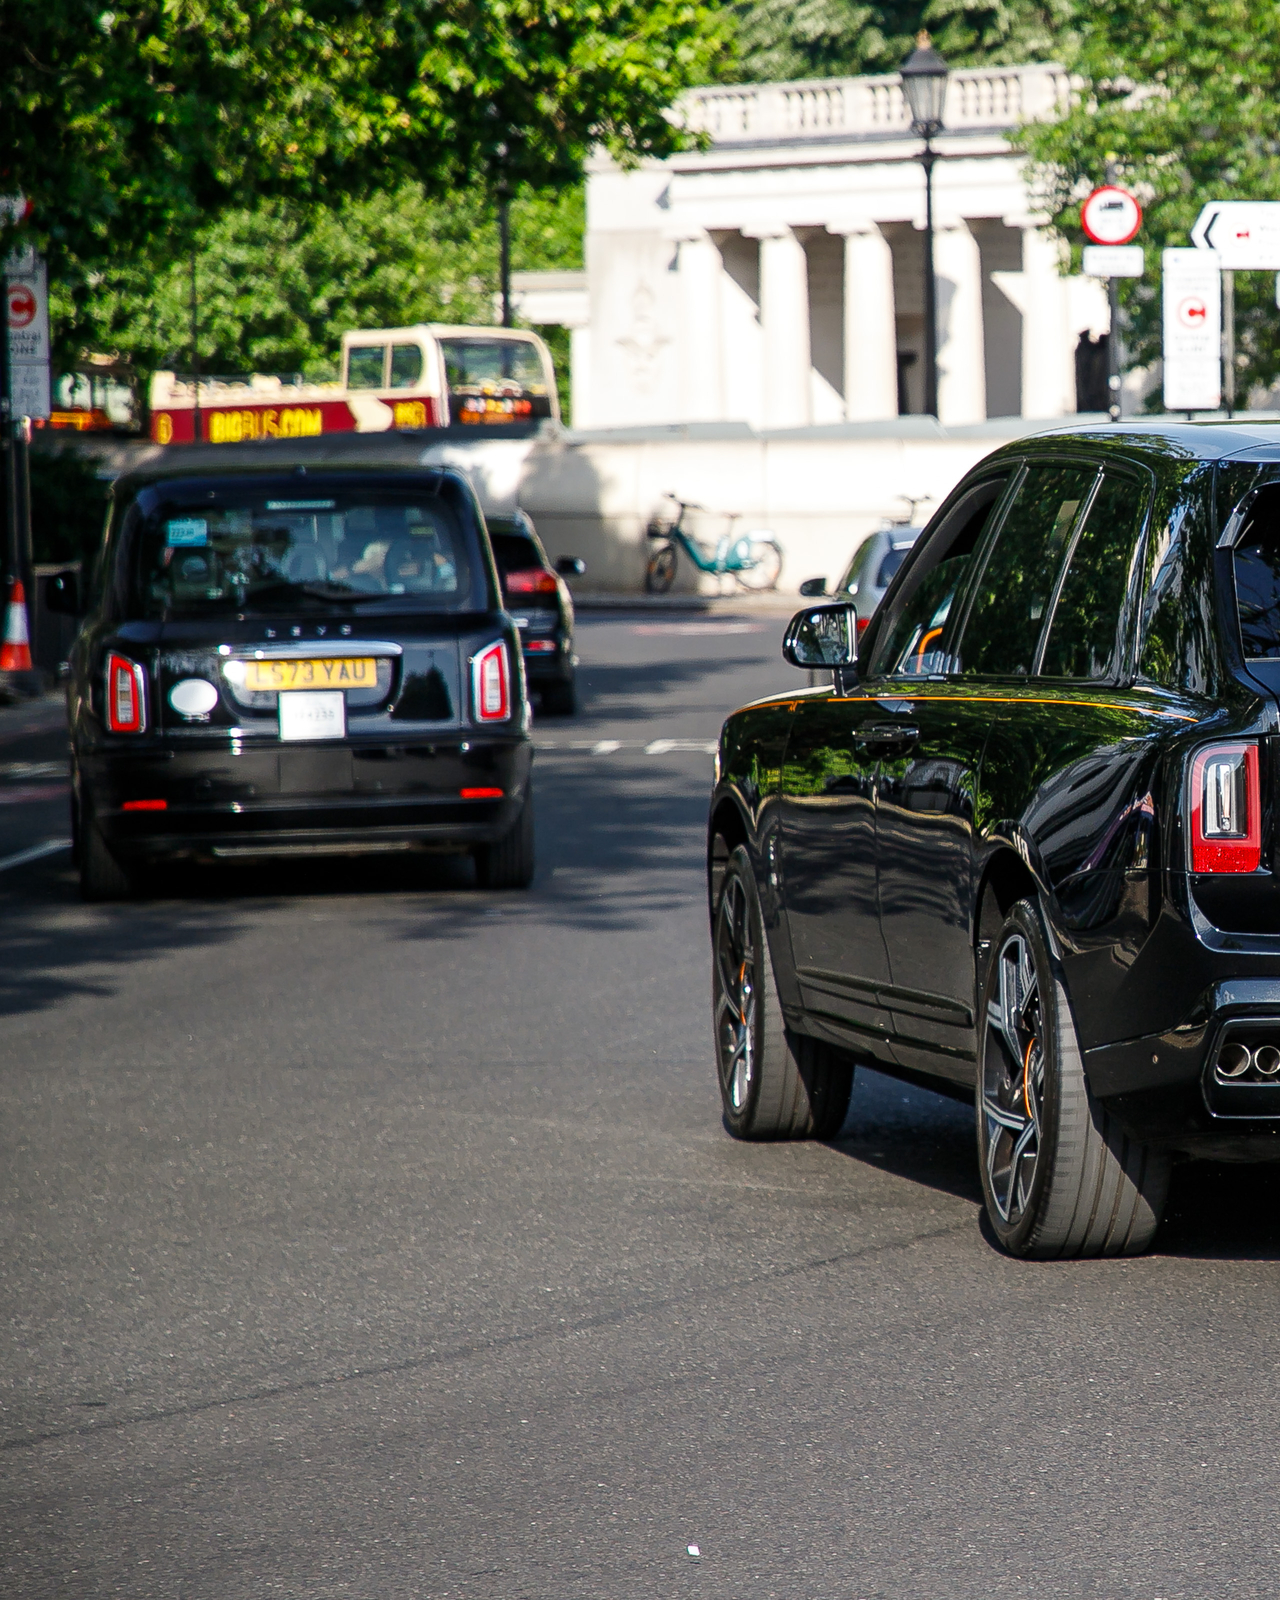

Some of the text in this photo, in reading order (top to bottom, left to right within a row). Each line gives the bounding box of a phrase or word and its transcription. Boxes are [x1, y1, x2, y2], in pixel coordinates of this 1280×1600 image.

[209, 408, 322, 443] BIGBUS.COM
[254, 658, 367, 684] LS73 YAU
